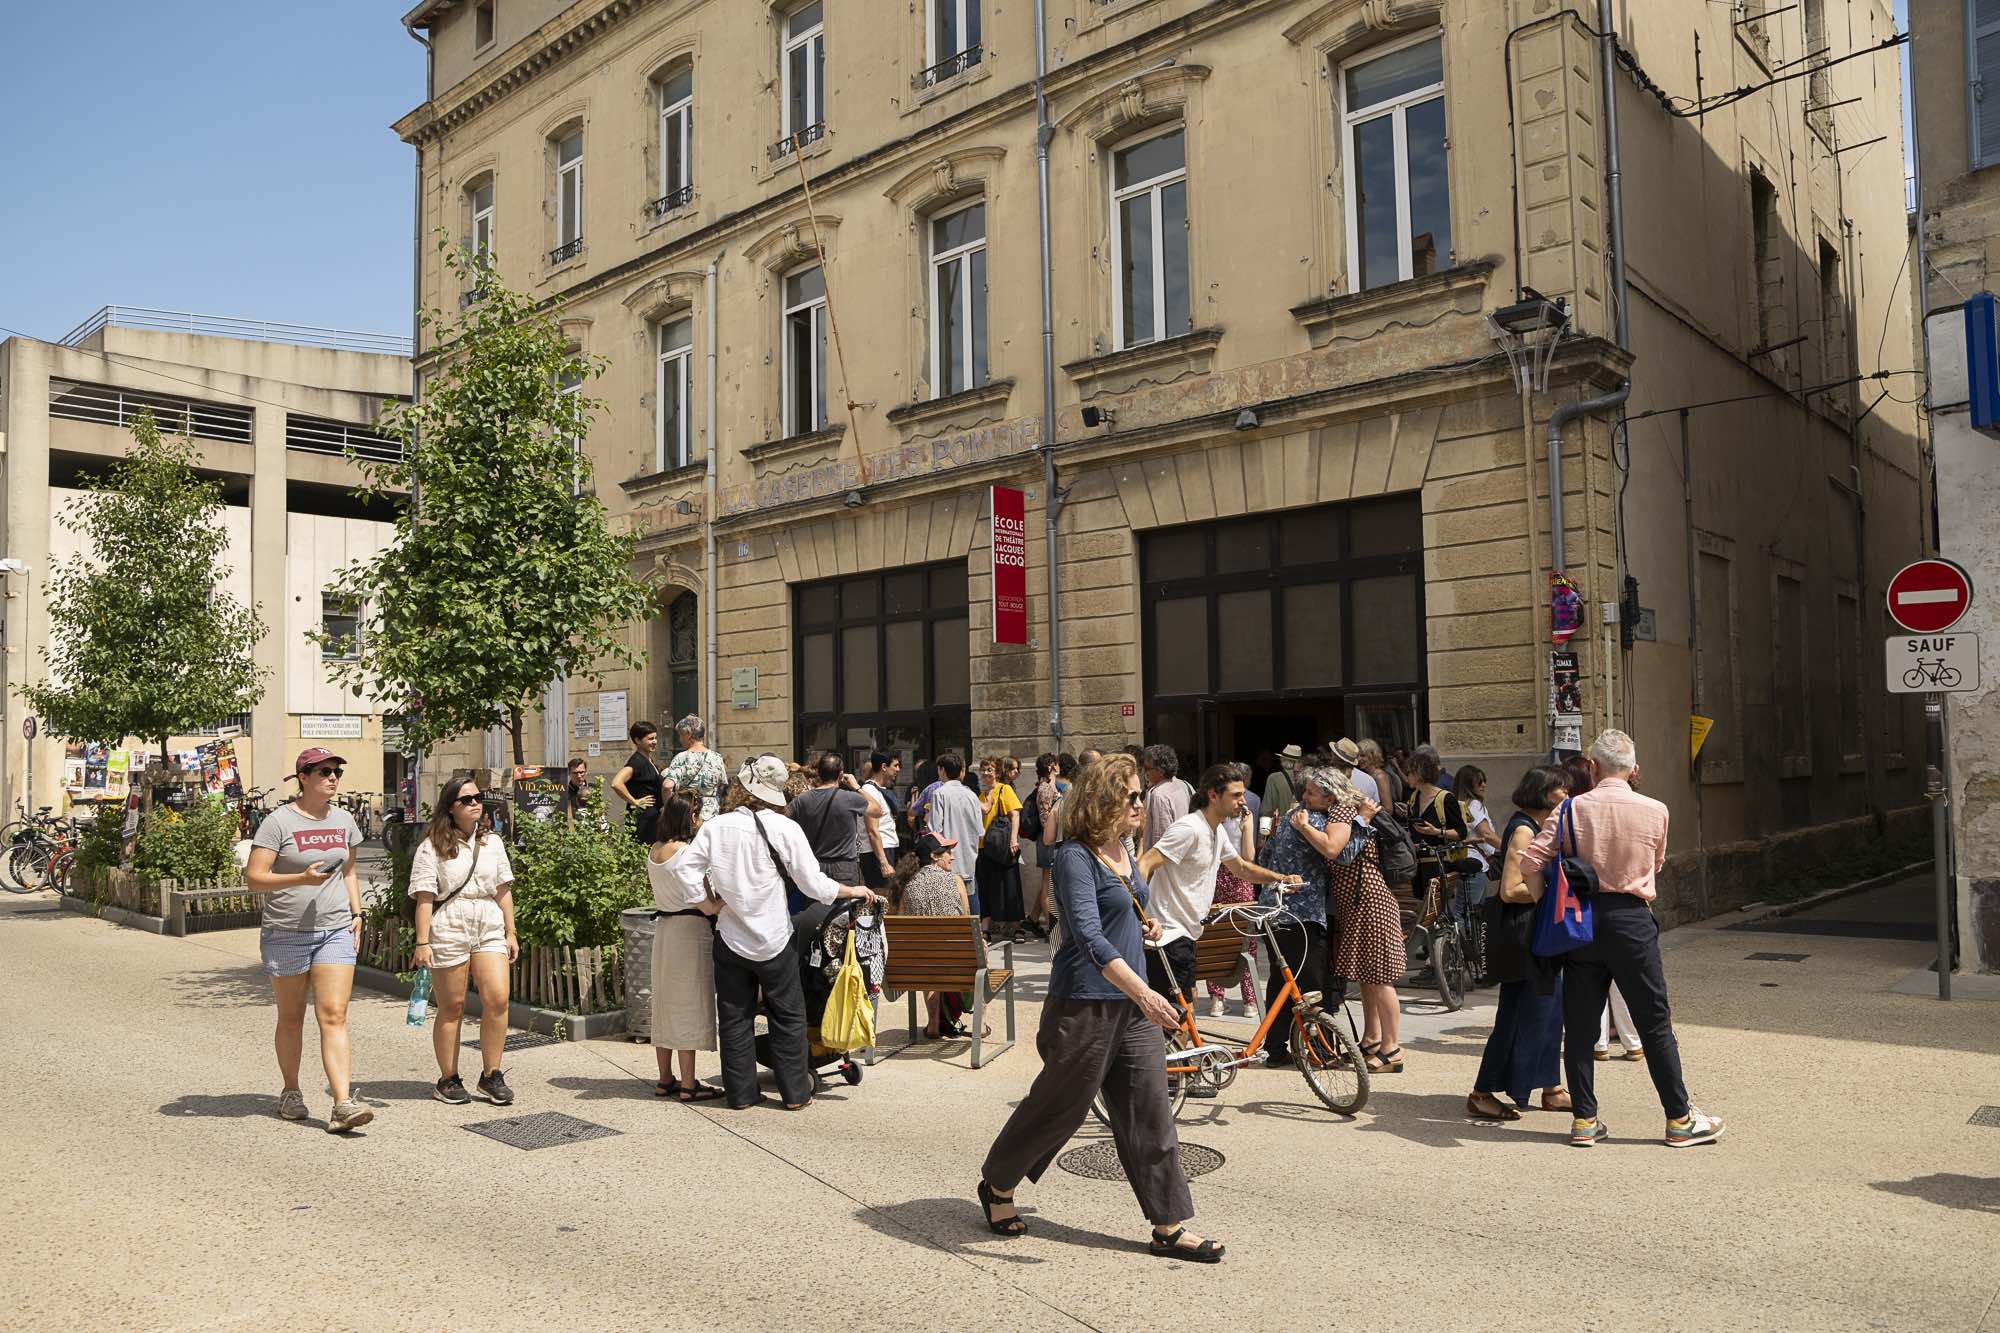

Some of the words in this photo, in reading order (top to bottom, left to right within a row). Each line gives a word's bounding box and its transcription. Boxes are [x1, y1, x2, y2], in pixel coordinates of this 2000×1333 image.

[994, 514, 1024, 531] ÉCOLE
[995, 534, 1002, 542] DE
[995, 543, 1025, 555] JACQUES
[995, 552, 1025, 567] LECOQ
[1907, 637, 1956, 653] SAUF
[301, 833, 343, 845] Levi's
